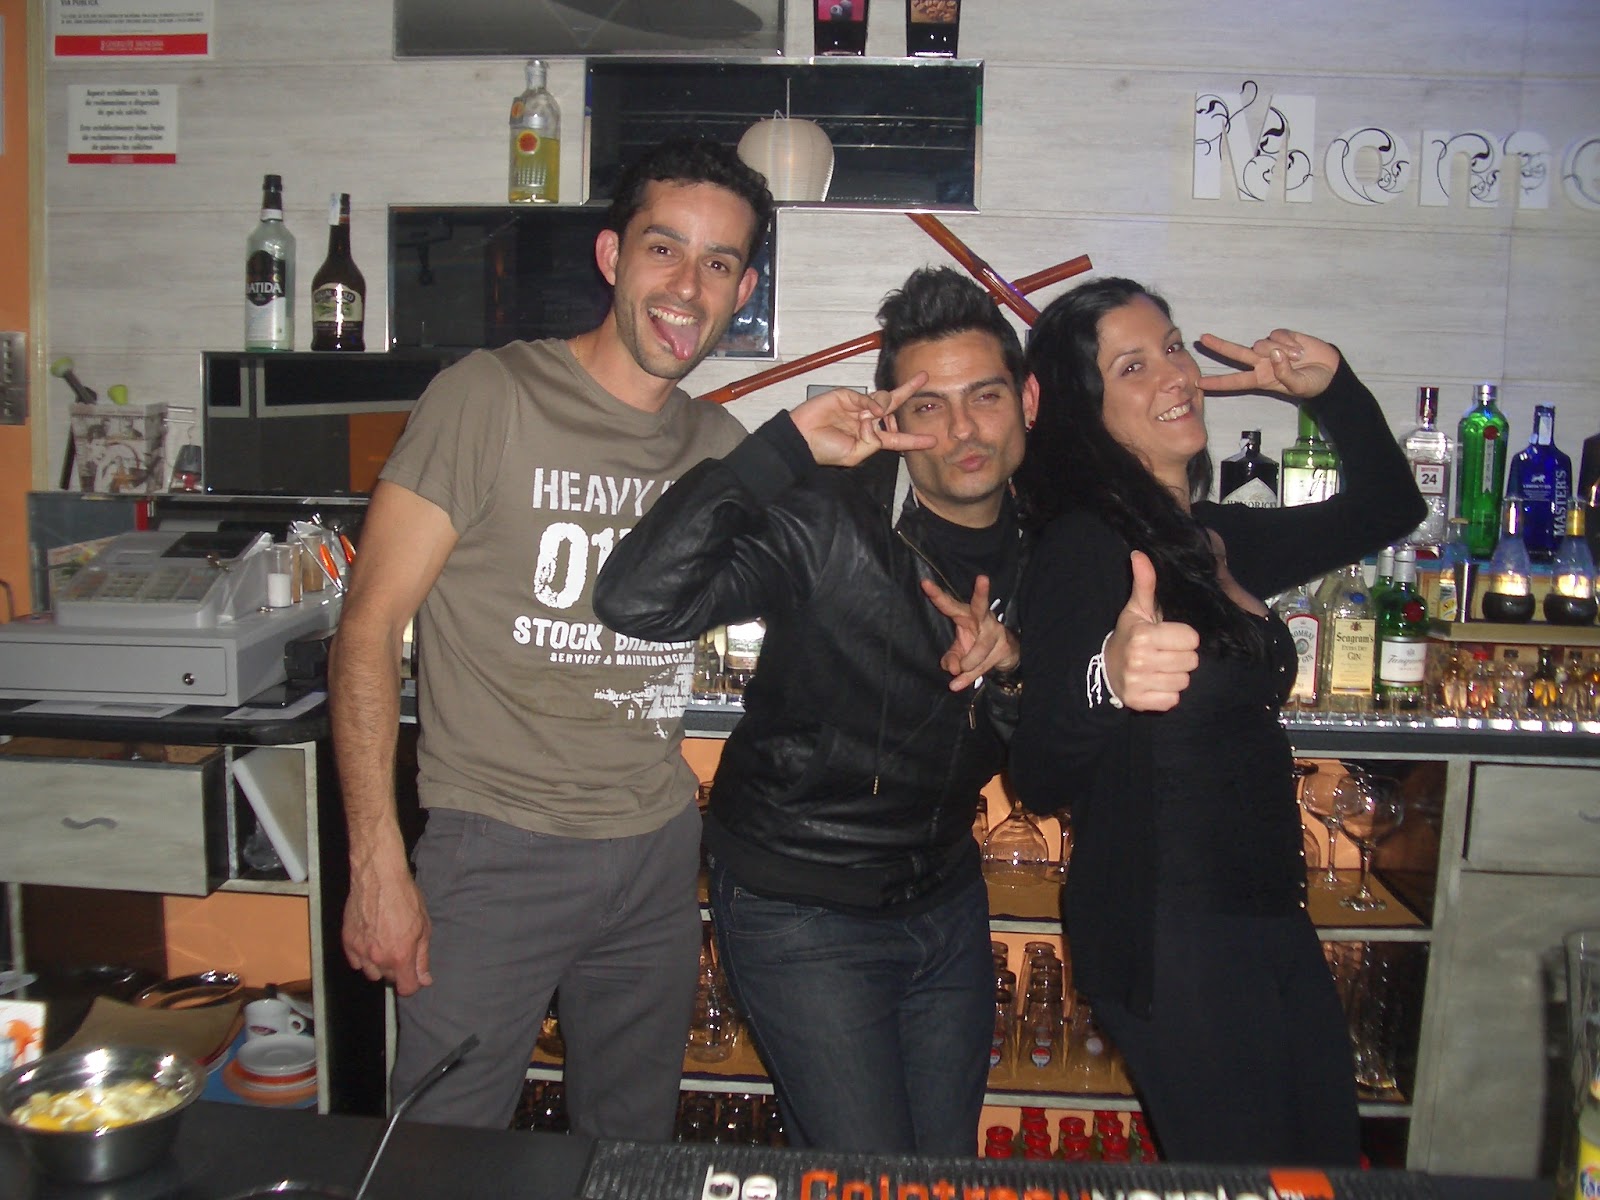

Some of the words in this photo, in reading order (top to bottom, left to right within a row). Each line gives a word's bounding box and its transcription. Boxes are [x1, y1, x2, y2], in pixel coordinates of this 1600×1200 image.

[1421, 473, 1438, 486] 24
[532, 467, 655, 517] HEAVY
[1552, 469, 1568, 538] MASTER'S
[513, 615, 604, 651] STOCK
[1336, 631, 1374, 645] Seagram's
[550, 652, 601, 665] SERVICE
[616, 653, 684, 667] MAINTENANCE
[1347, 652, 1361, 661] GIN
